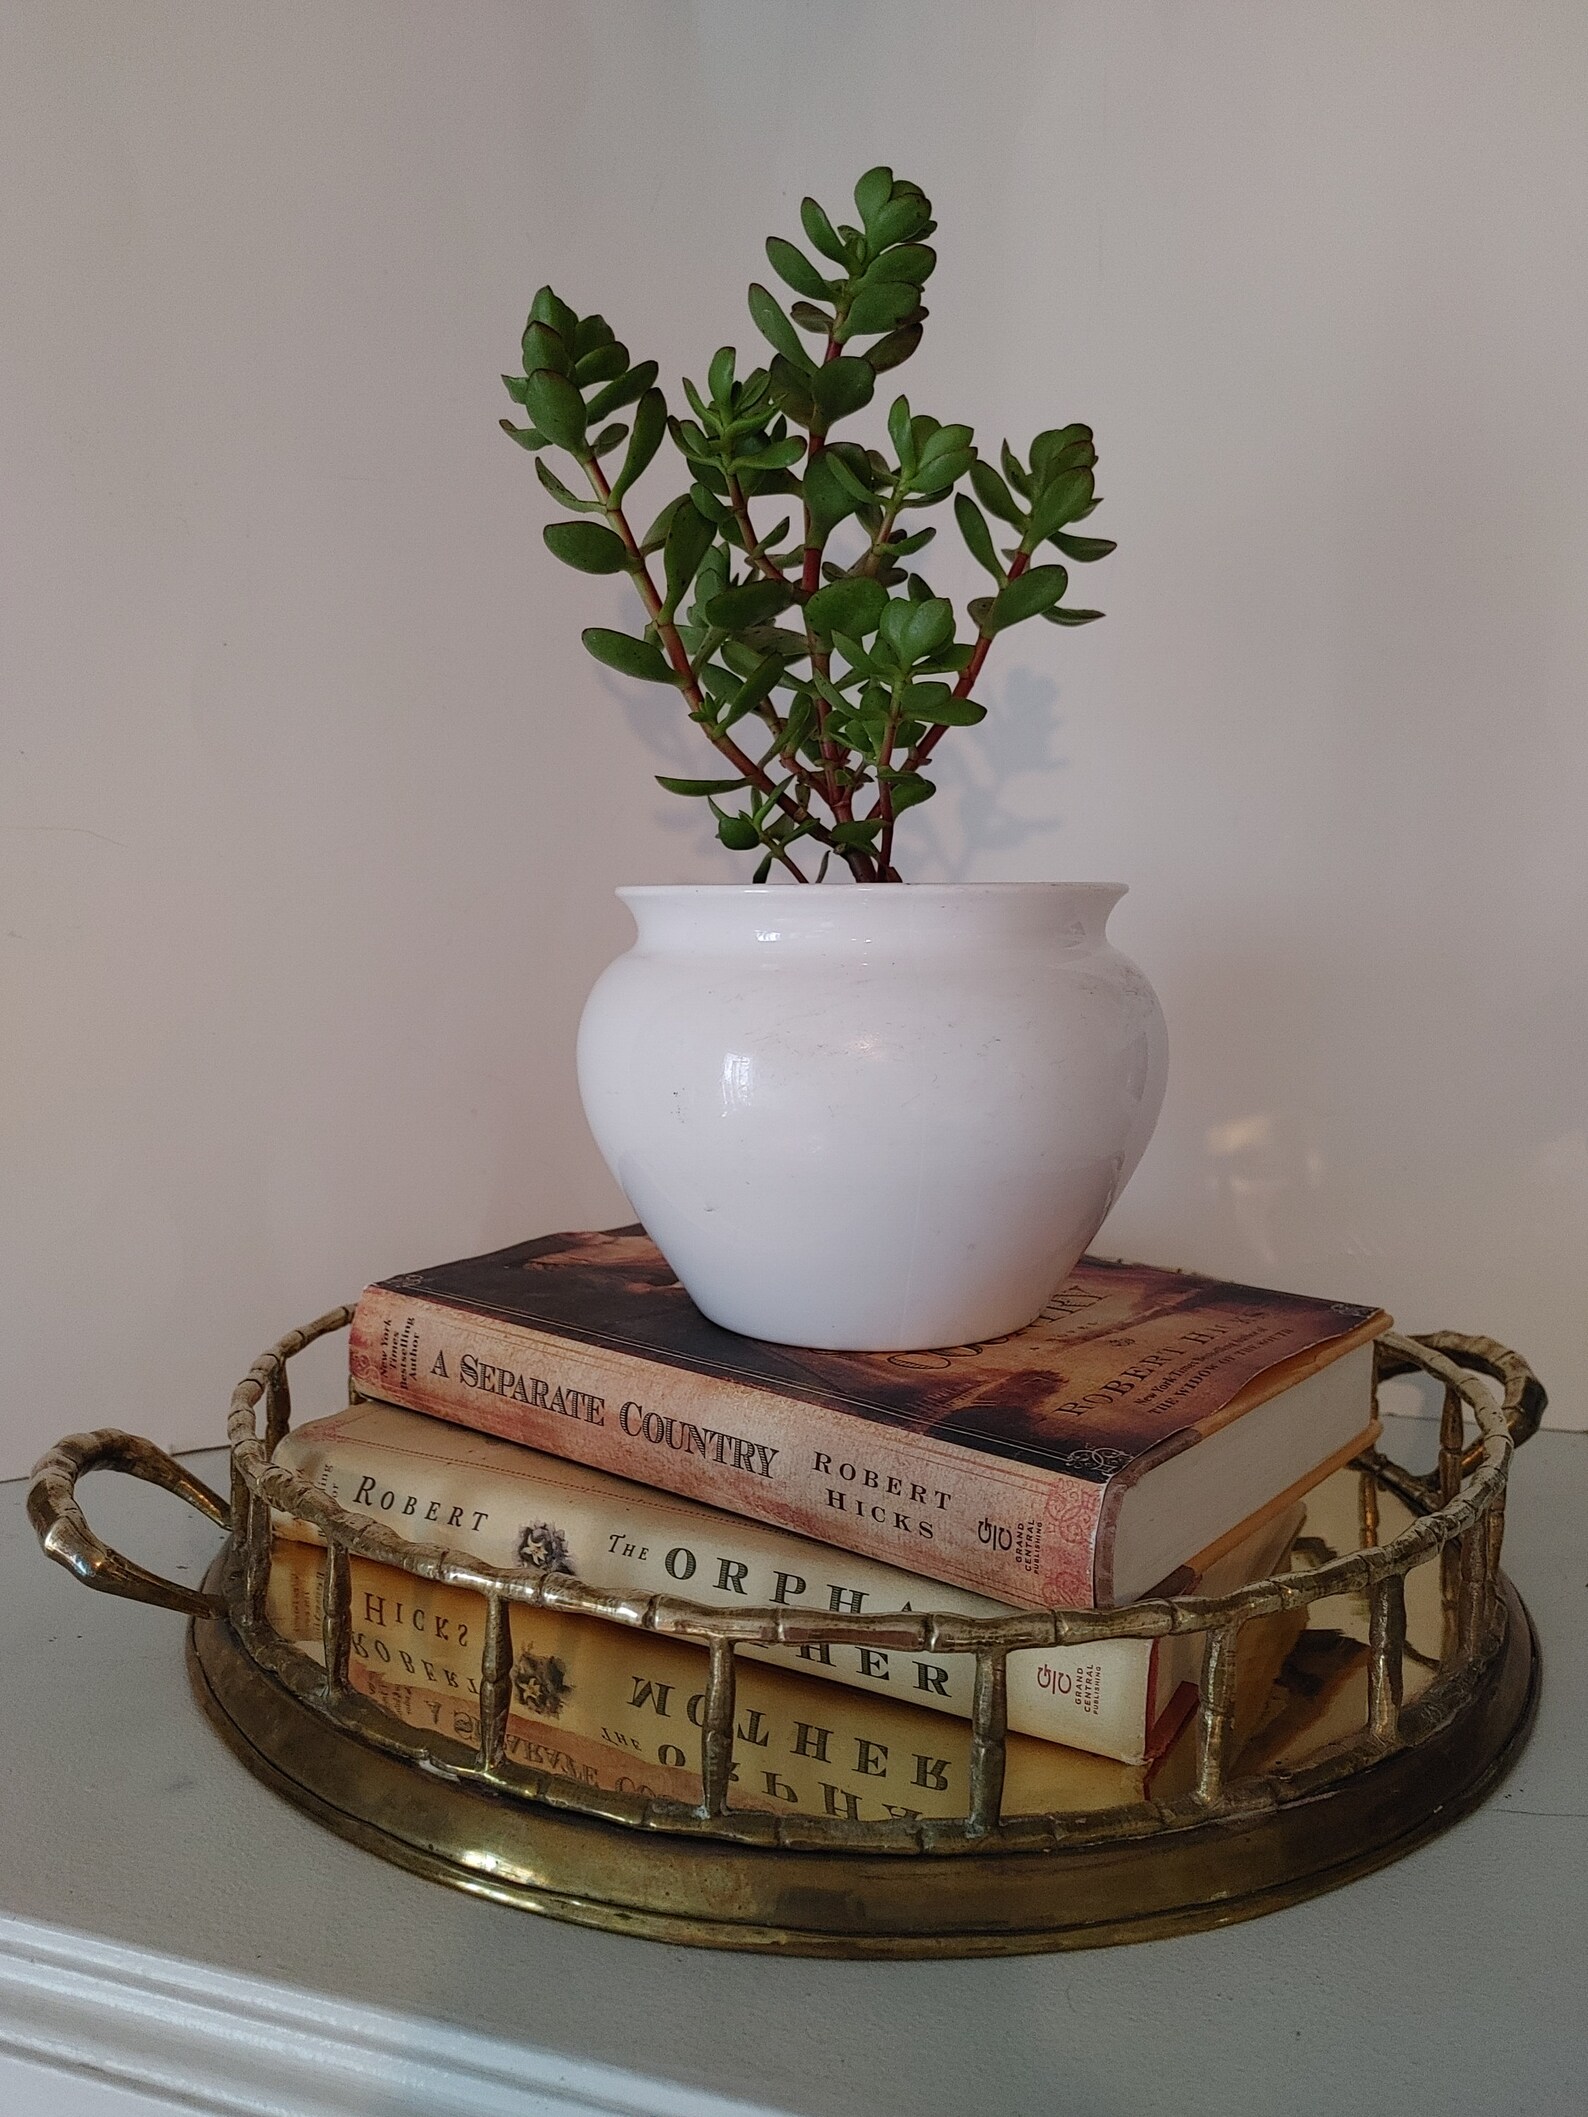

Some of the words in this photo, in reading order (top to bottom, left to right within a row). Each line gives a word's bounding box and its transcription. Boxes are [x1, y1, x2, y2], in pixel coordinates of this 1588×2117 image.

[379, 1319, 392, 1347] York
[388, 1331, 400, 1370] Times
[400, 1316, 416, 1390] Bestselling
[408, 1331, 420, 1382] Author
[380, 1350, 389, 1378] New
[1051, 1346, 1186, 1417] ROBERT
[1151, 1376, 1179, 1394] York
[430, 1349, 450, 1379] A
[459, 1353, 606, 1427] SEPARATE
[618, 1400, 780, 1479] COUNTRY
[1147, 1397, 1182, 1416] THE
[352, 1475, 490, 1533] ROBERT
[812, 1450, 954, 1511] ROBERT
[825, 1487, 935, 1540] HICKS
[608, 1533, 650, 1563] THE
[1015, 1522, 1025, 1563] GRAND
[1024, 1519, 1035, 1572] CENTRAL
[1033, 1521, 1043, 1576] PUBLISHING
[1074, 1667, 1084, 1705] GRAND
[1084, 1663, 1094, 1713] CENTRAL
[1093, 1665, 1102, 1716] PUBLISHING
